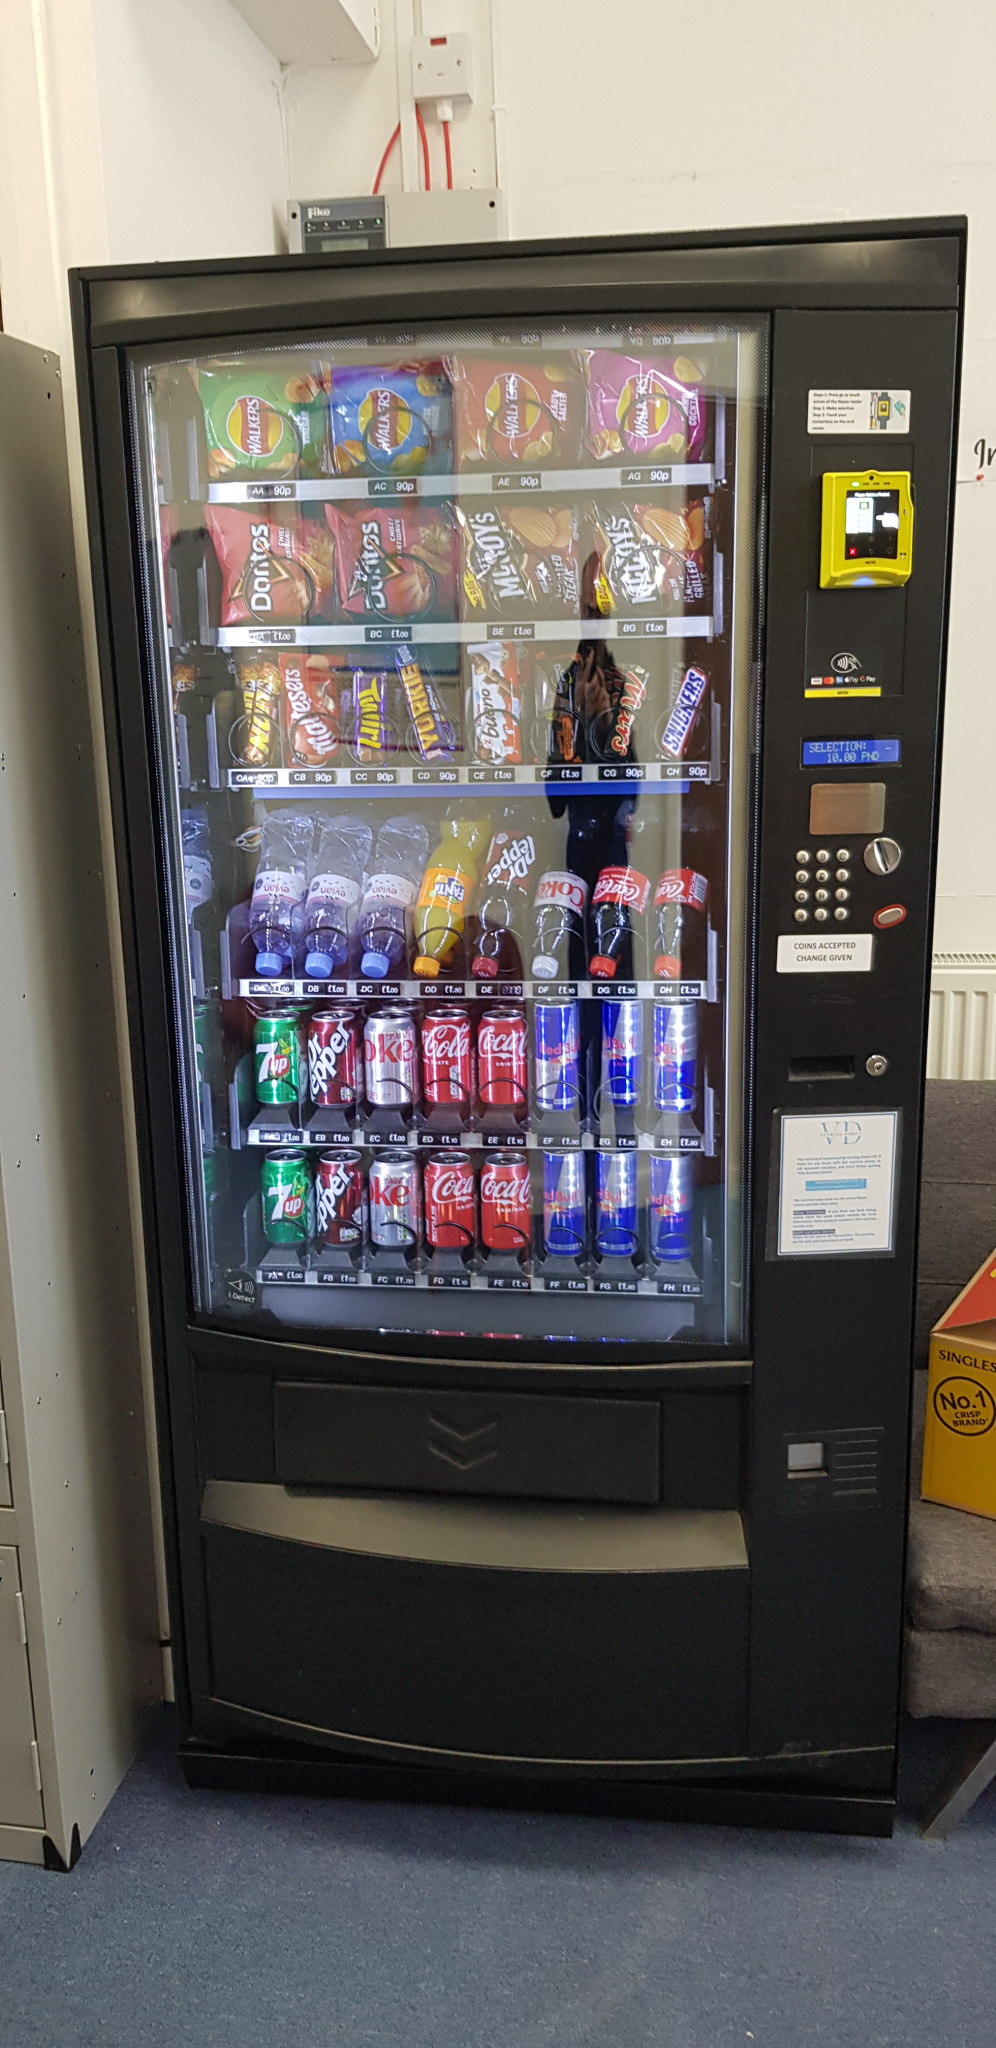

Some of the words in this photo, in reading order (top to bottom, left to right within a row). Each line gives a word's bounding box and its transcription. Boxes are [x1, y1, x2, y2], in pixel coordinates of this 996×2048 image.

[374, 390, 391, 449] WALKERS
[246, 397, 262, 457] WALKERS
[627, 471, 642, 481] AG
[650, 470, 669, 483] 90p
[373, 482, 387, 491] AC
[396, 481, 415, 493] 90p
[498, 477, 511, 487] AE
[520, 476, 539, 488] 90p
[252, 486, 265, 496] AA
[273, 485, 292, 497] 90p
[250, 522, 272, 613] Doritos
[361, 521, 386, 610] Doritos
[492, 627, 504, 636] BE
[513, 627, 532, 636] £1.00
[623, 624, 636, 633] BG
[645, 623, 664, 633] £1.00
[273, 632, 291, 642] £1.00
[370, 630, 382, 639] BC
[391, 629, 409, 639] £1.00
[285, 669, 339, 755] Maltesers
[400, 663, 439, 751] YORKIE
[662, 671, 705, 752] SNICKERS
[358, 676, 382, 750] Twirl
[481, 688, 500, 739] bueno
[611, 671, 647, 756] Mars
[809, 742, 867, 753] SELECTION:
[827, 753, 856, 763] 10.00
[861, 752, 879, 762] PND
[355, 773, 367, 781] CC
[377, 772, 394, 783] 90p
[418, 772, 430, 780] CD
[439, 772, 456, 782] 90p
[473, 772, 485, 780] CE
[494, 771, 512, 780] £1.00
[541, 770, 552, 779] CF
[561, 770, 579, 779] £1.30
[604, 769, 617, 778] CG
[625, 769, 643, 779] 90p
[666, 768, 679, 776] CH
[688, 768, 706, 777] 90p
[294, 773, 306, 782] CB
[315, 773, 332, 783] 90p
[487, 835, 536, 885] Pepper
[264, 884, 290, 894] evian
[320, 886, 346, 897] evian
[372, 885, 398, 895] evian
[434, 882, 465, 902] FANTA
[794, 942, 817, 950] COINS
[796, 954, 827, 962] CHANGE
[308, 985, 319, 993] DB
[328, 985, 345, 993] £1.00
[361, 985, 373, 993] DC
[382, 985, 399, 994] £1.00
[425, 985, 437, 993] DD
[481, 985, 493, 994] DE
[538, 985, 549, 994] DF
[558, 985, 576, 995] £1.10
[597, 986, 610, 995] DG
[617, 985, 636, 995] £1.30
[660, 986, 673, 995] DH
[680, 985, 699, 995] £1.30
[364, 1033, 414, 1063] oke
[256, 1042, 278, 1084] 7
[310, 1020, 350, 1097] epper
[315, 1134, 326, 1142] EB
[333, 1134, 350, 1142] £1.00
[369, 1135, 381, 1143] EC
[389, 1134, 405, 1142] £1.00
[488, 1136, 498, 1144] EE
[599, 1138, 611, 1146] EG
[661, 1139, 672, 1147] EH
[267, 1183, 293, 1221] 7
[285, 1200, 301, 1214] up
[287, 1271, 303, 1280] £1.00
[323, 1274, 334, 1282] FB
[433, 1277, 444, 1285] FD
[494, 1279, 504, 1287] FE
[600, 1282, 611, 1290] FG
[233, 1293, 256, 1304] Detect
[938, 1350, 996, 1373] SINGLES
[939, 1390, 987, 1411] No.1
[954, 1411, 981, 1419] CRISP
